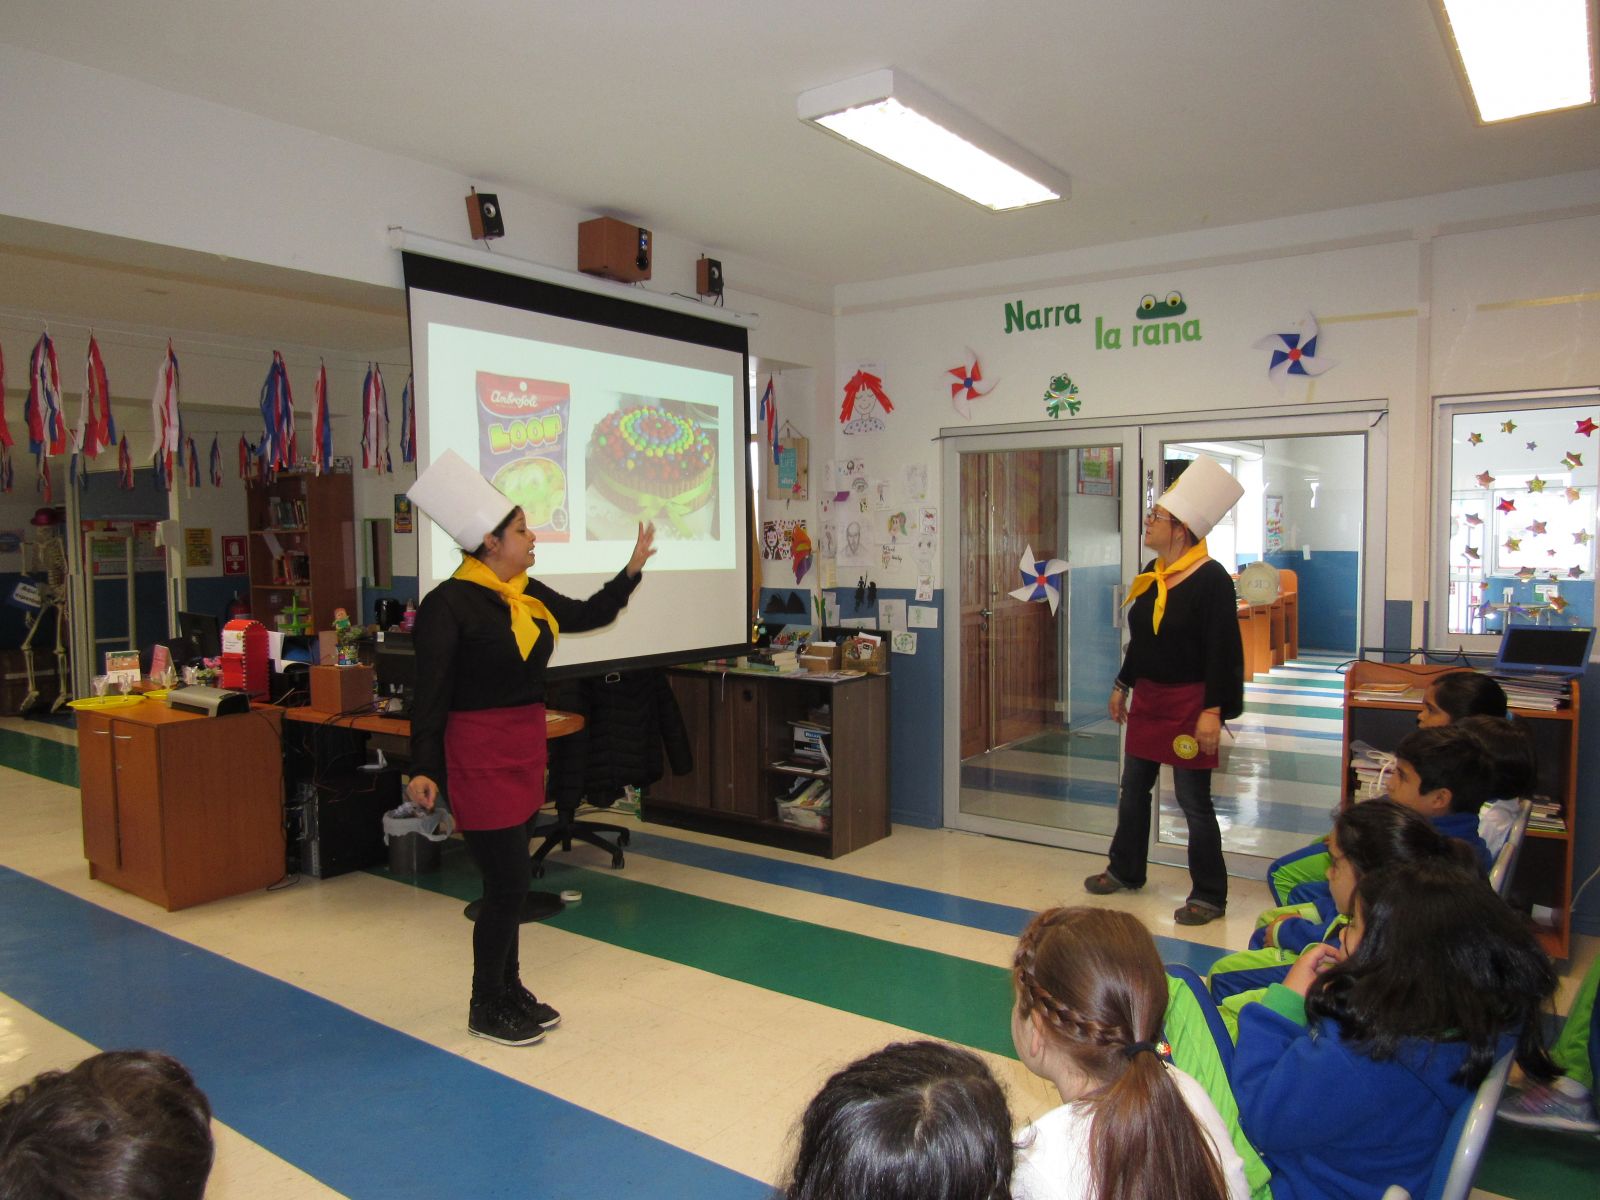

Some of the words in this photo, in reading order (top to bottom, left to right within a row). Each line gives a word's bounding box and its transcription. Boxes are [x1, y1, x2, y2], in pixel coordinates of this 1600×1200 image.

[1004, 300, 1082, 334] Narra
[1095, 316, 1122, 350] la
[1132, 318, 1202, 347] rana
